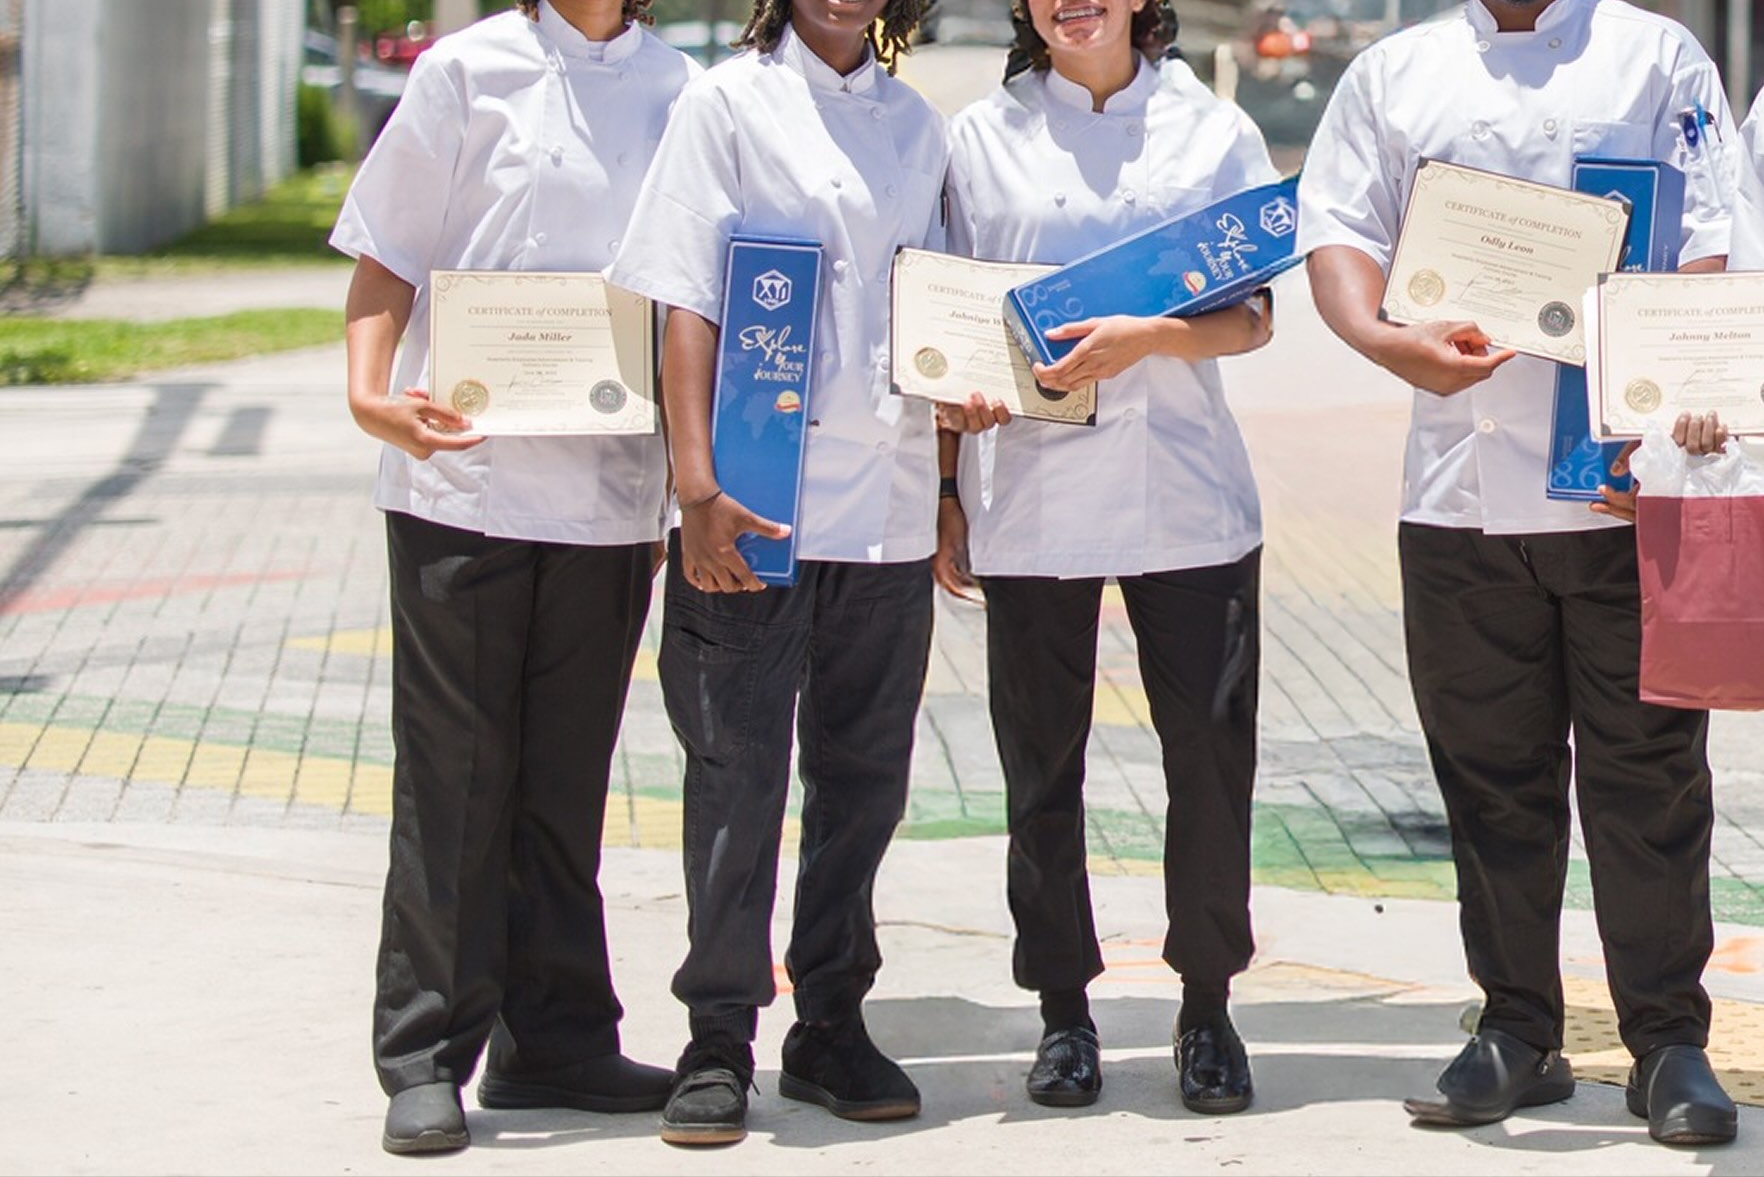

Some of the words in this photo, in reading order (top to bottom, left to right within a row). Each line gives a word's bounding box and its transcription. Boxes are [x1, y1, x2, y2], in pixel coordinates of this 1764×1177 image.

[1444, 200, 1507, 222] CERTIFICATE
[1508, 216, 1519, 226] of
[1519, 217, 1583, 239] COMPLETION
[928, 284, 985, 301] CERTIFICATE
[467, 306, 533, 316] CERTIFICATE
[536, 306, 547, 317] of
[547, 307, 613, 317] COMPLETION
[1637, 308, 1701, 318] CERTIFICATE
[1704, 307, 1715, 317] of
[538, 332, 572, 342] Miller
[1668, 331, 1711, 342] Johnny
[1712, 331, 1751, 341] Melton
